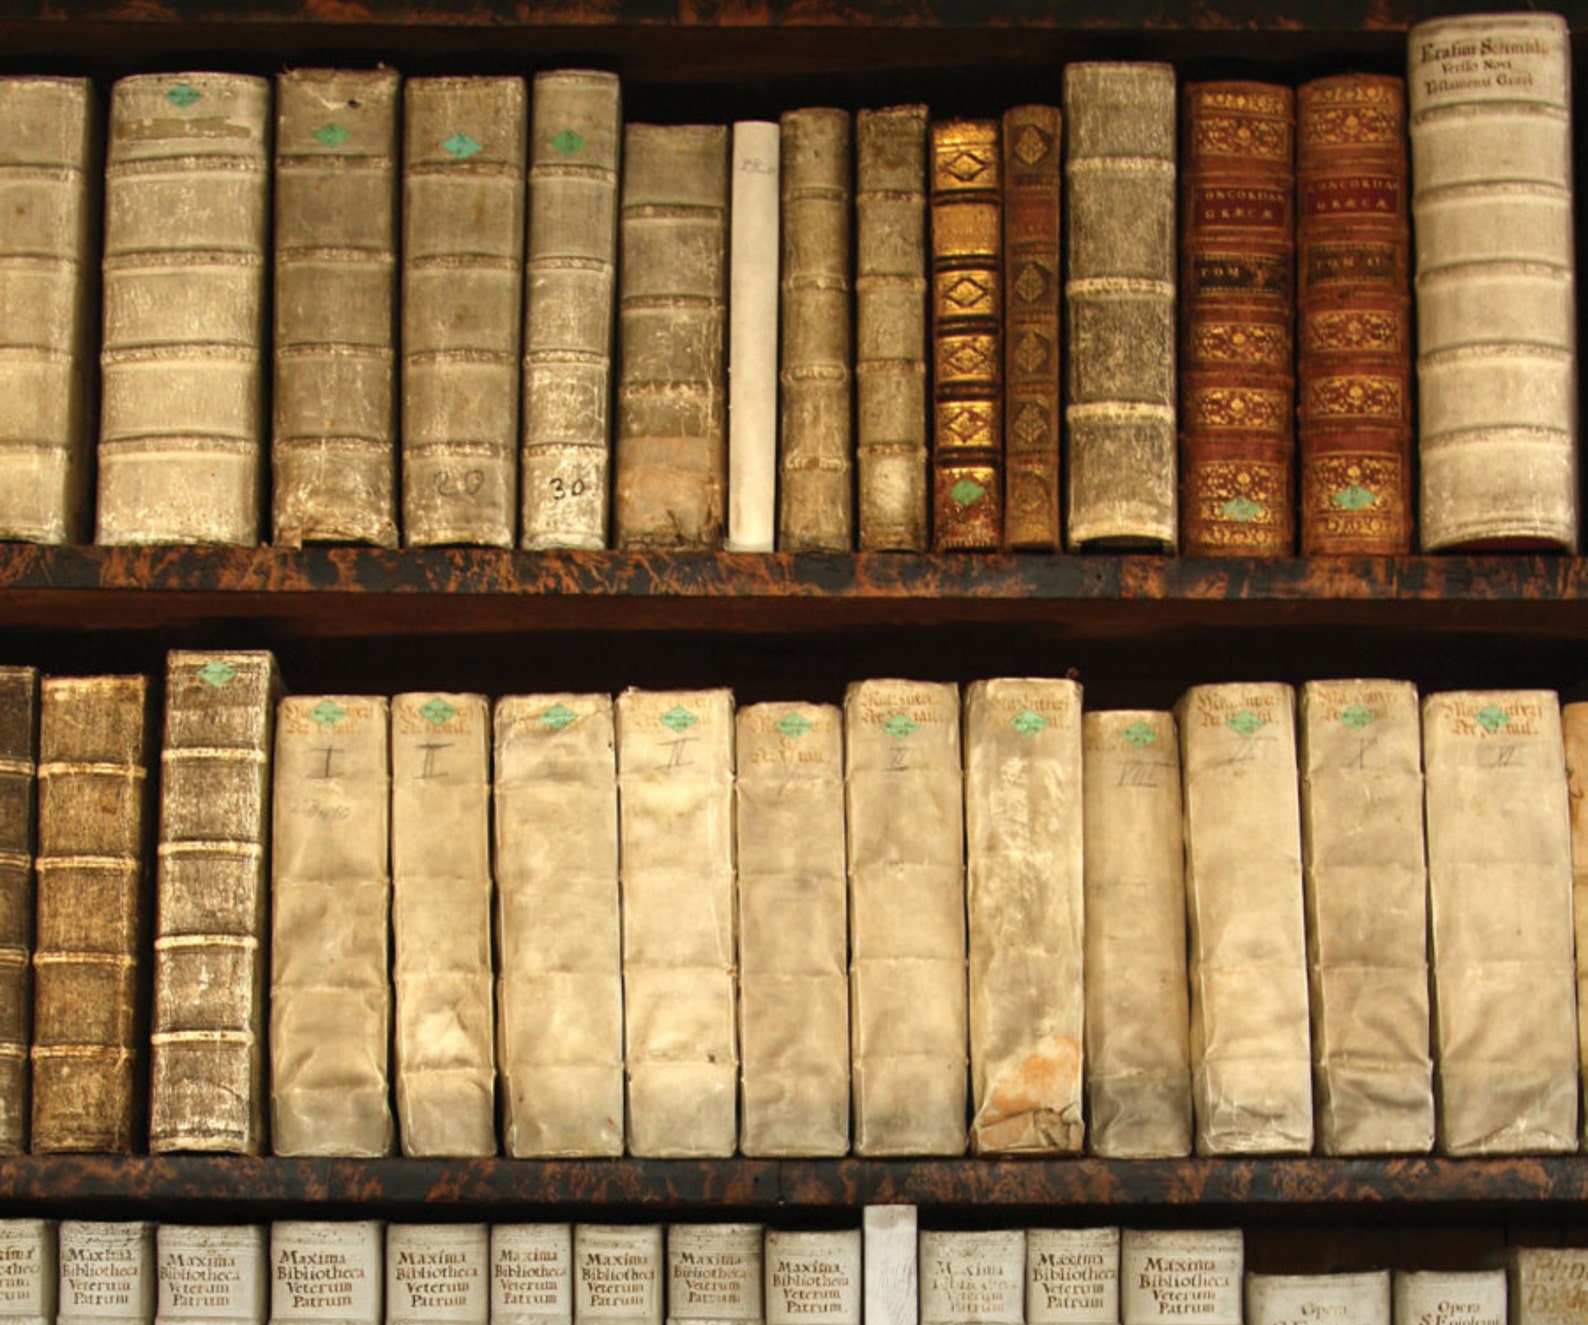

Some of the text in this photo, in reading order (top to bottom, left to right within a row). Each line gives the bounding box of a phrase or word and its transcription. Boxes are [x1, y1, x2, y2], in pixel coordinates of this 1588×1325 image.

[550, 477, 585, 500] 30
[279, 1249, 346, 1265] Maxima
[397, 1251, 466, 1265] Maxima
[585, 1253, 648, 1267] Maxima
[680, 1251, 742, 1265] Maxima
[1037, 1253, 1104, 1267] Maxima
[495, 1263, 566, 1278] Bibliotheca
[777, 1260, 840, 1273] Maxima
[1144, 1257, 1216, 1273] Maxima
[277, 1266, 365, 1281] Bibliotheca
[396, 1265, 478, 1281] Bibliotheca
[582, 1267, 654, 1281] Bibliotheca
[773, 1273, 849, 1287] Bibliotheca
[1033, 1265, 1116, 1282] Bibliotheca
[406, 1281, 469, 1294] Veterum
[500, 1279, 557, 1291] Veterum
[686, 1280, 740, 1291] Veterum
[1139, 1272, 1230, 1289] Bibliotheca
[286, 1282, 352, 1294] Veterum
[587, 1282, 644, 1294] Veterum
[783, 1288, 841, 1300] Veterum
[1041, 1282, 1104, 1295] Veterum
[1152, 1289, 1216, 1301] Veterum
[172, 1294, 229, 1307] Patrum
[292, 1294, 352, 1308] Patrum
[411, 1294, 467, 1308] Patrum
[504, 1293, 557, 1305] Patrum
[591, 1294, 644, 1307] Patrum
[1047, 1296, 1103, 1309] Patrum
[787, 1301, 842, 1313] Patrum
[1158, 1302, 1215, 1315] Patrum
